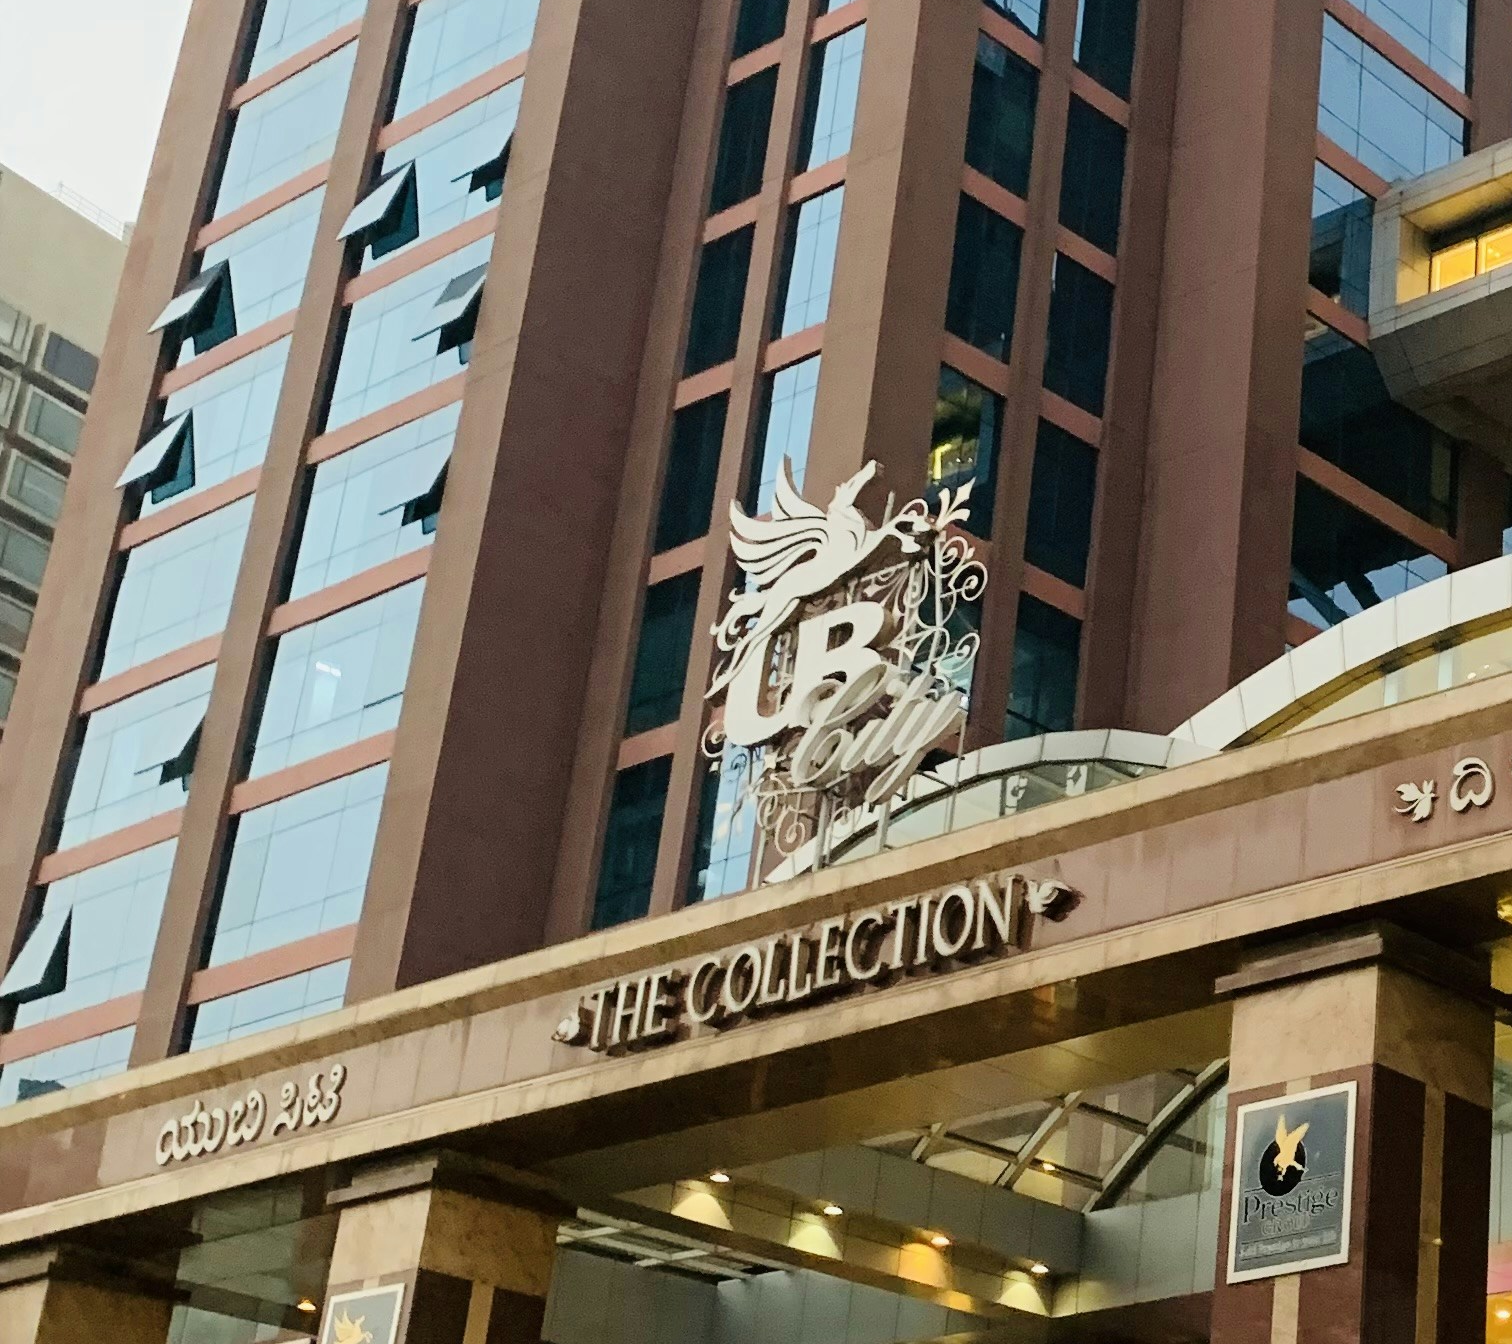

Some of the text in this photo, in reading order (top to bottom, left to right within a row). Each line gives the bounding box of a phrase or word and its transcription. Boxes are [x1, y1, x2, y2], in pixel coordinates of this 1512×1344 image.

[724, 600, 886, 746] UB
[791, 660, 965, 804] City
[1450, 757, 1493, 812] ದಿ
[589, 874, 1024, 1049] THE COLLECTION
[273, 1063, 346, 1136] ಸಿಟಿ
[1243, 1187, 1339, 1224] Prestige
